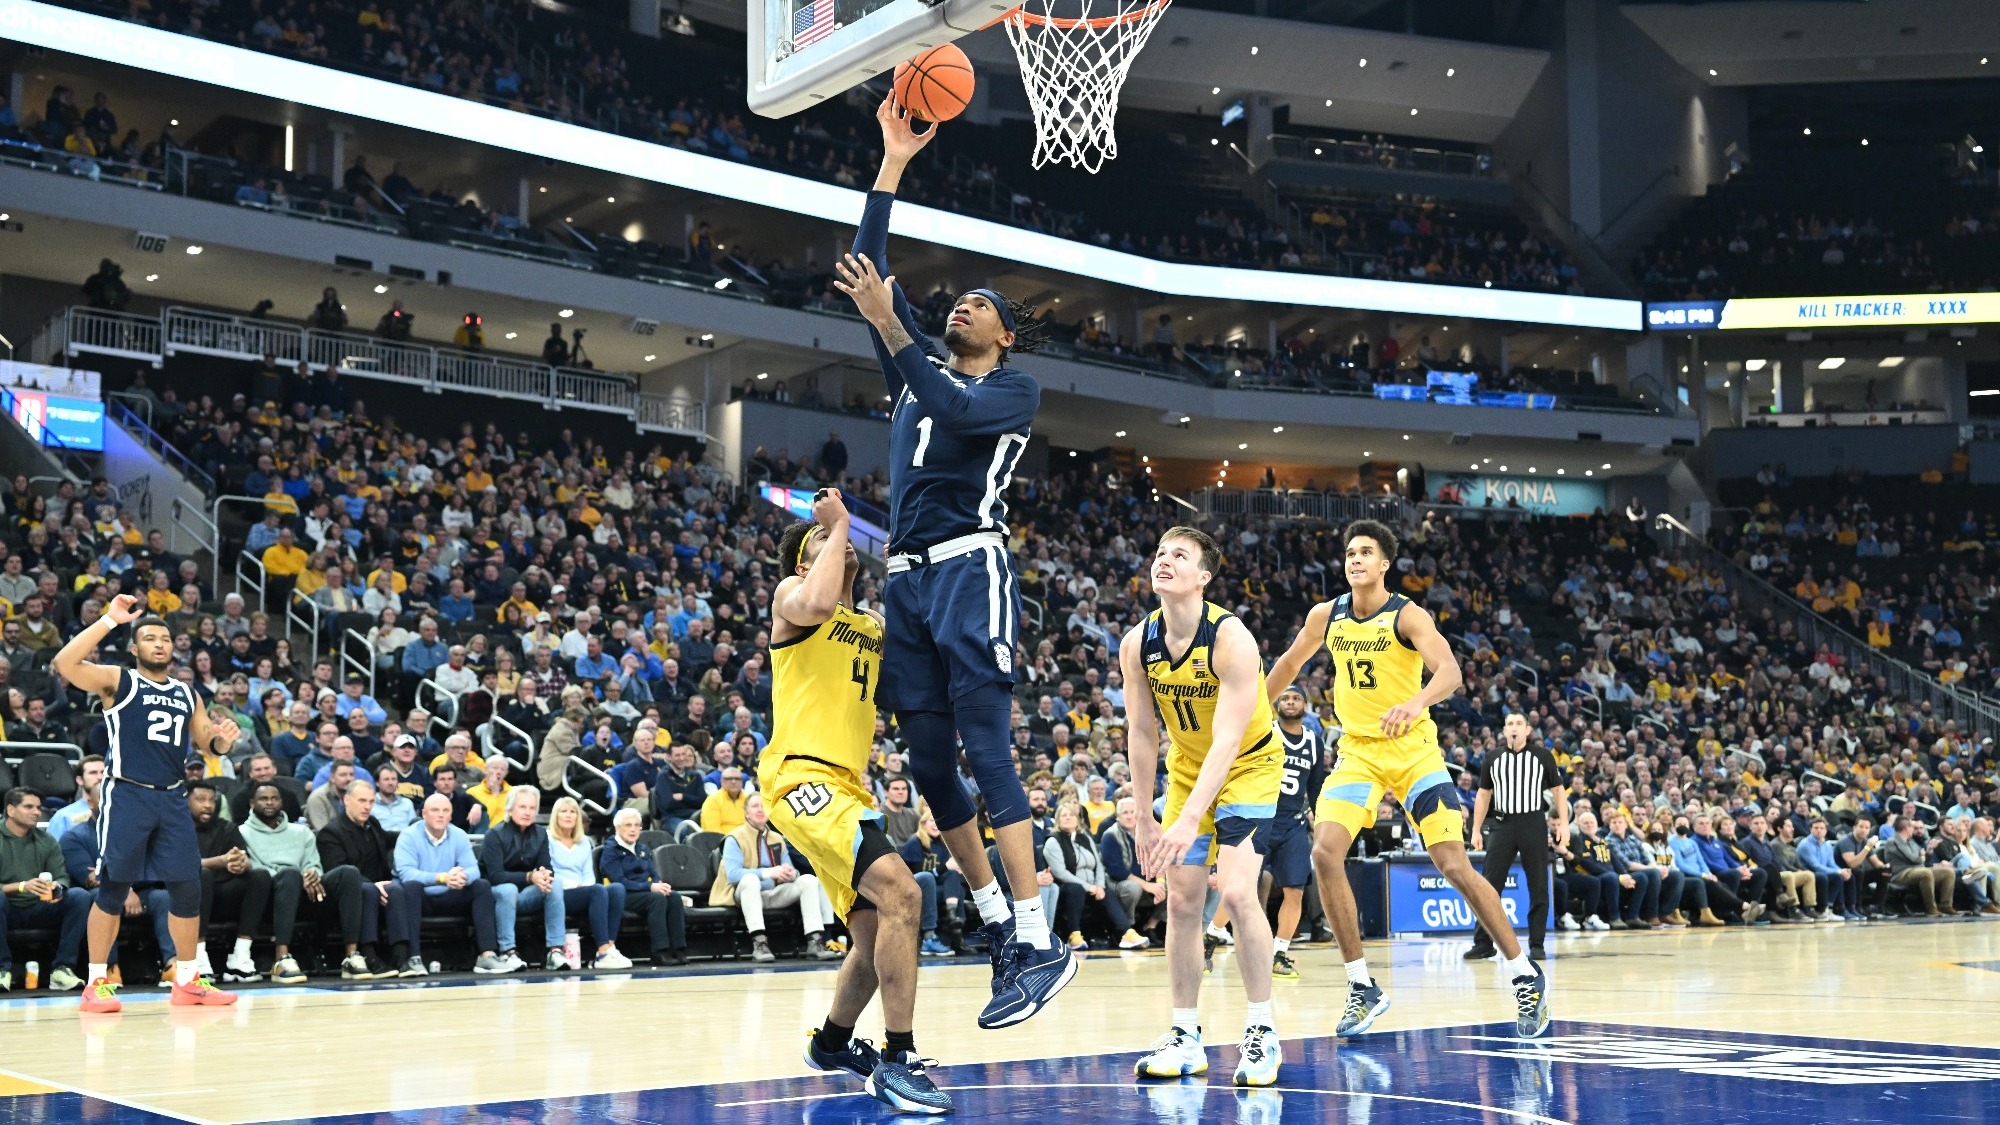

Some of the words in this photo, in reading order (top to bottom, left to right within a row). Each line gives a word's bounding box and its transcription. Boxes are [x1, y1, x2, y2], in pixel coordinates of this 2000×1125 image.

[136, 235, 167, 253] 106
[1687, 308, 1714, 324] PM
[1798, 304, 1828, 318] KILL
[1834, 302, 1907, 317] TRACKER:
[1927, 300, 1968, 315] XXXX
[632, 320, 657, 336] 106
[912, 416, 933, 468] 1
[1484, 477, 1558, 506] KONA
[1331, 634, 1392, 657] Marquette
[851, 656, 870, 702] 4
[1346, 658, 1377, 690] 13
[1149, 676, 1218, 702] Marquette
[142, 694, 189, 713] BUTLER
[1171, 699, 1201, 732] 11
[147, 709, 186, 747] 21
[1280, 767, 1300, 796] 5
[1420, 877, 1437, 889] ONE
[1422, 898, 1519, 928] GRUR
